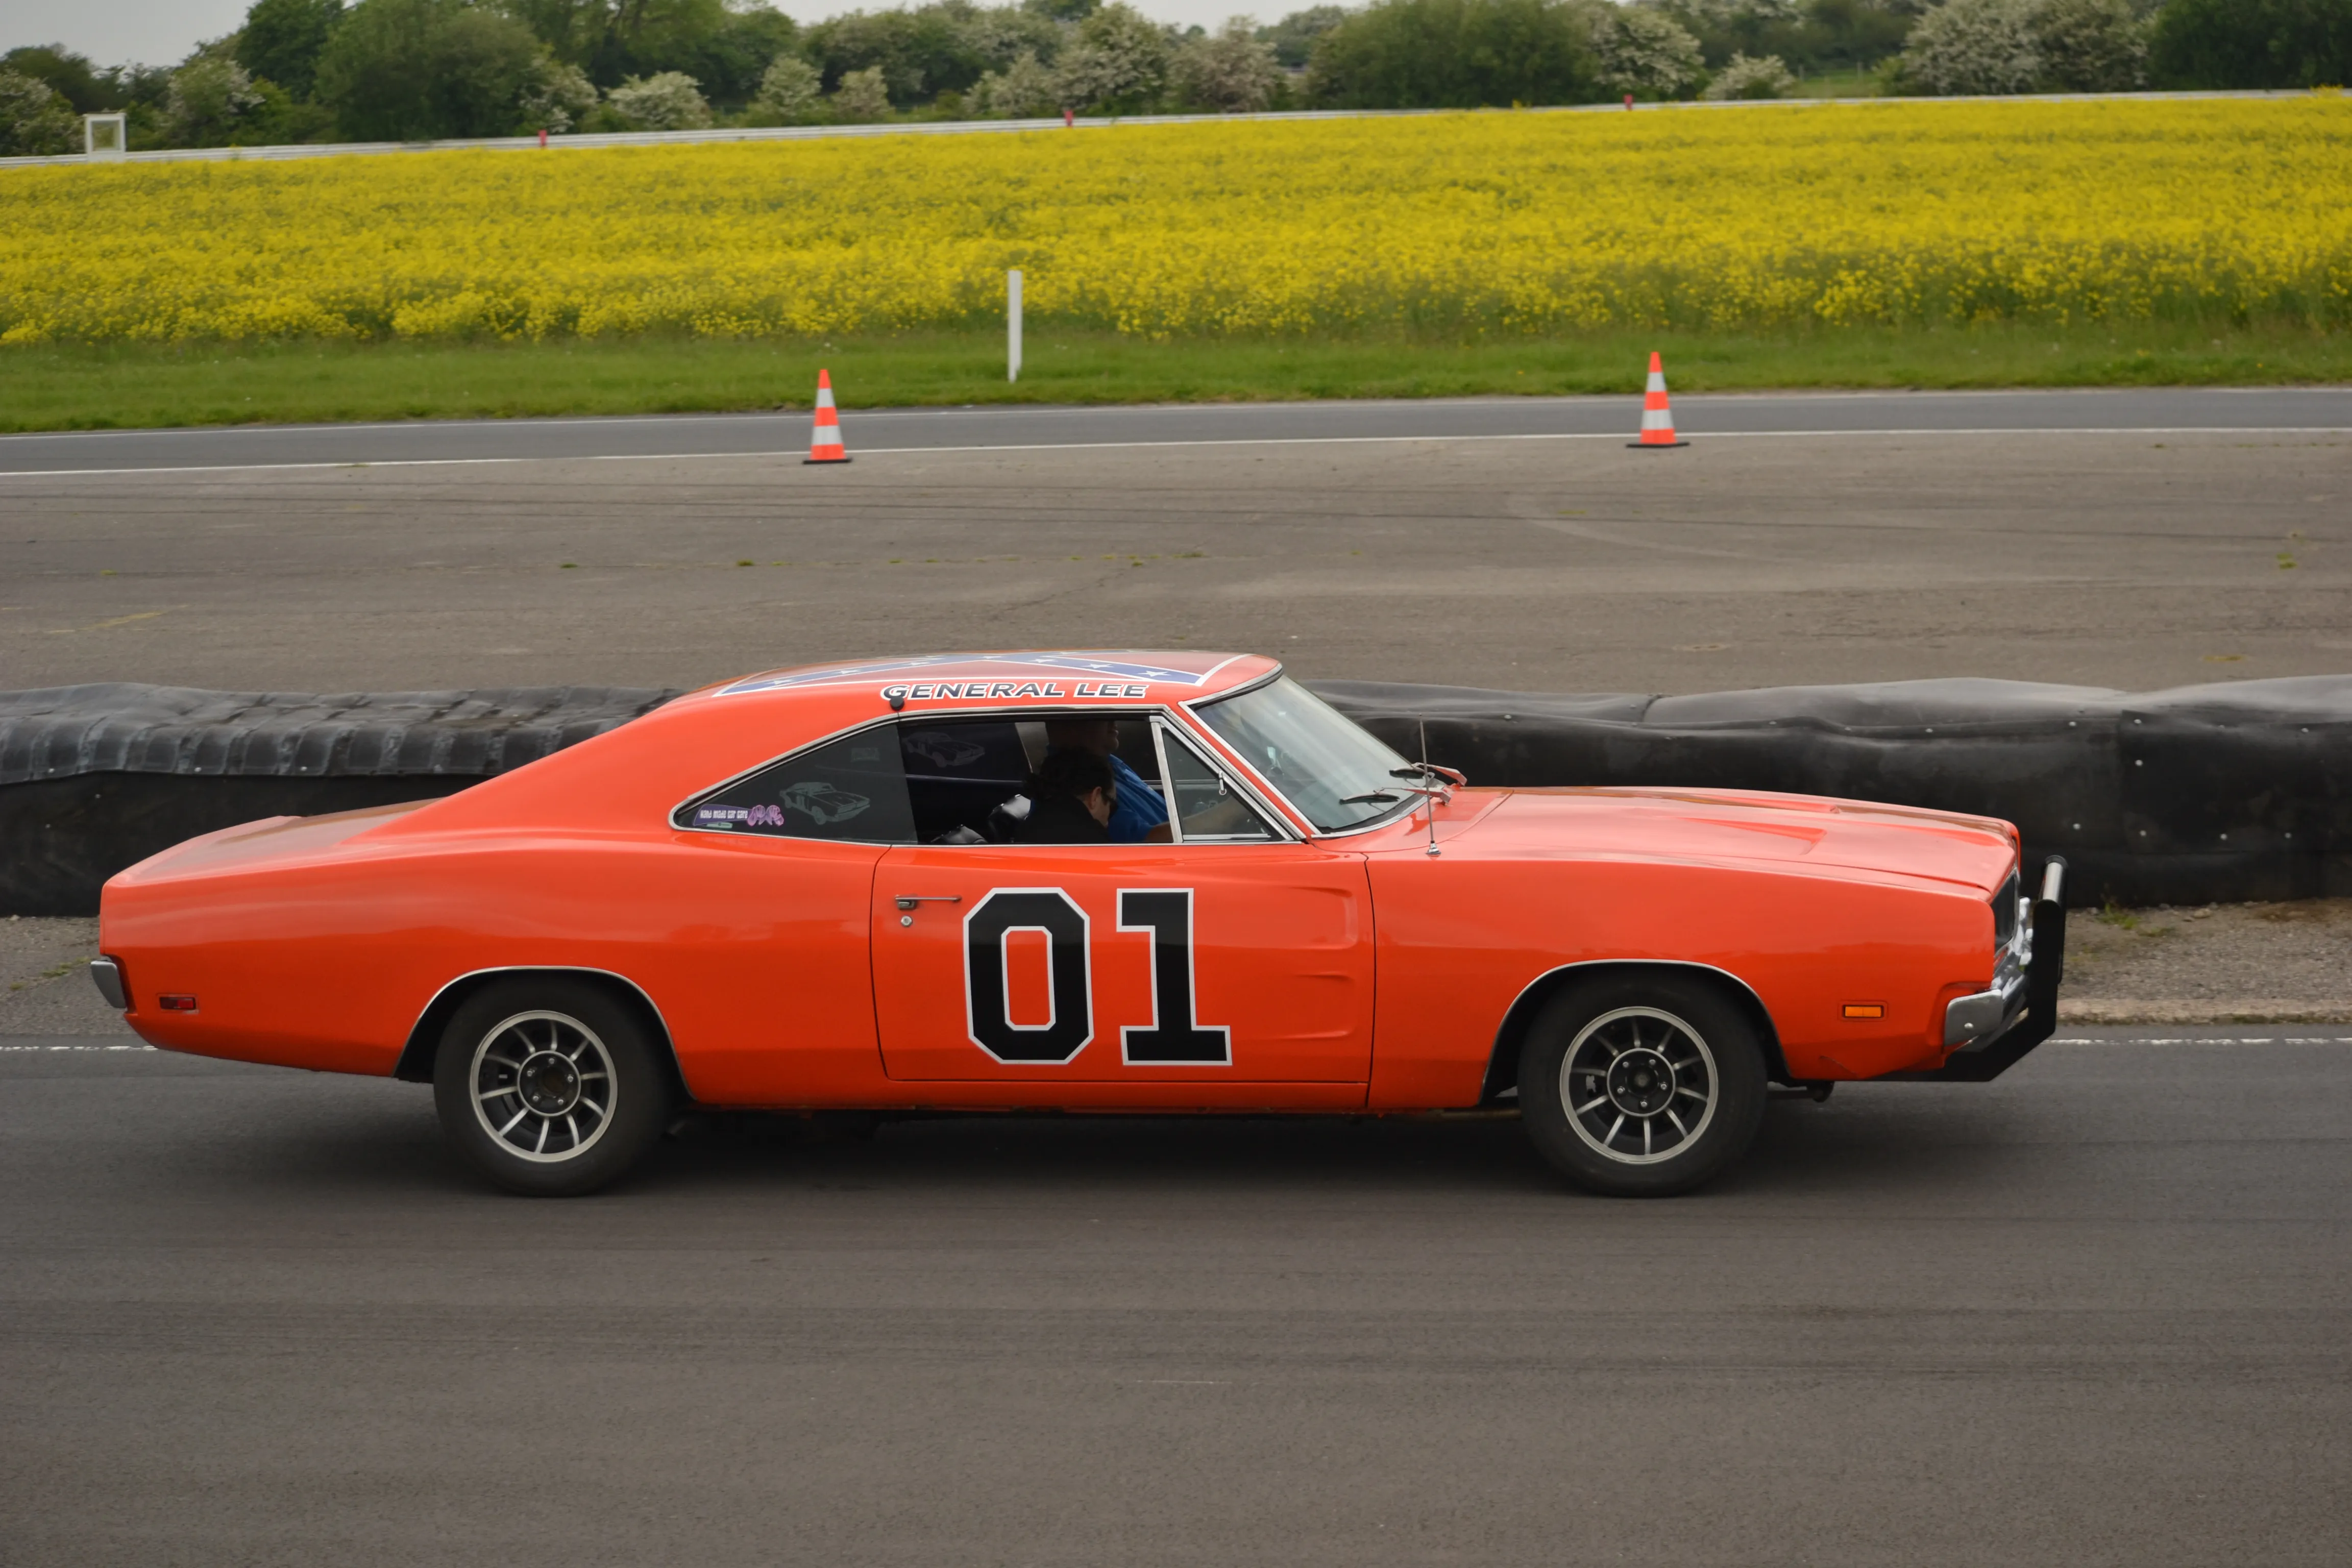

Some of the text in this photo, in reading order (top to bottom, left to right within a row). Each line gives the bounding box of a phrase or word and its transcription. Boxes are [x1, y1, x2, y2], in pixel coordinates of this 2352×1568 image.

[880, 683, 1149, 701] GENERAL LEE
[964, 887, 1232, 1065] 01
